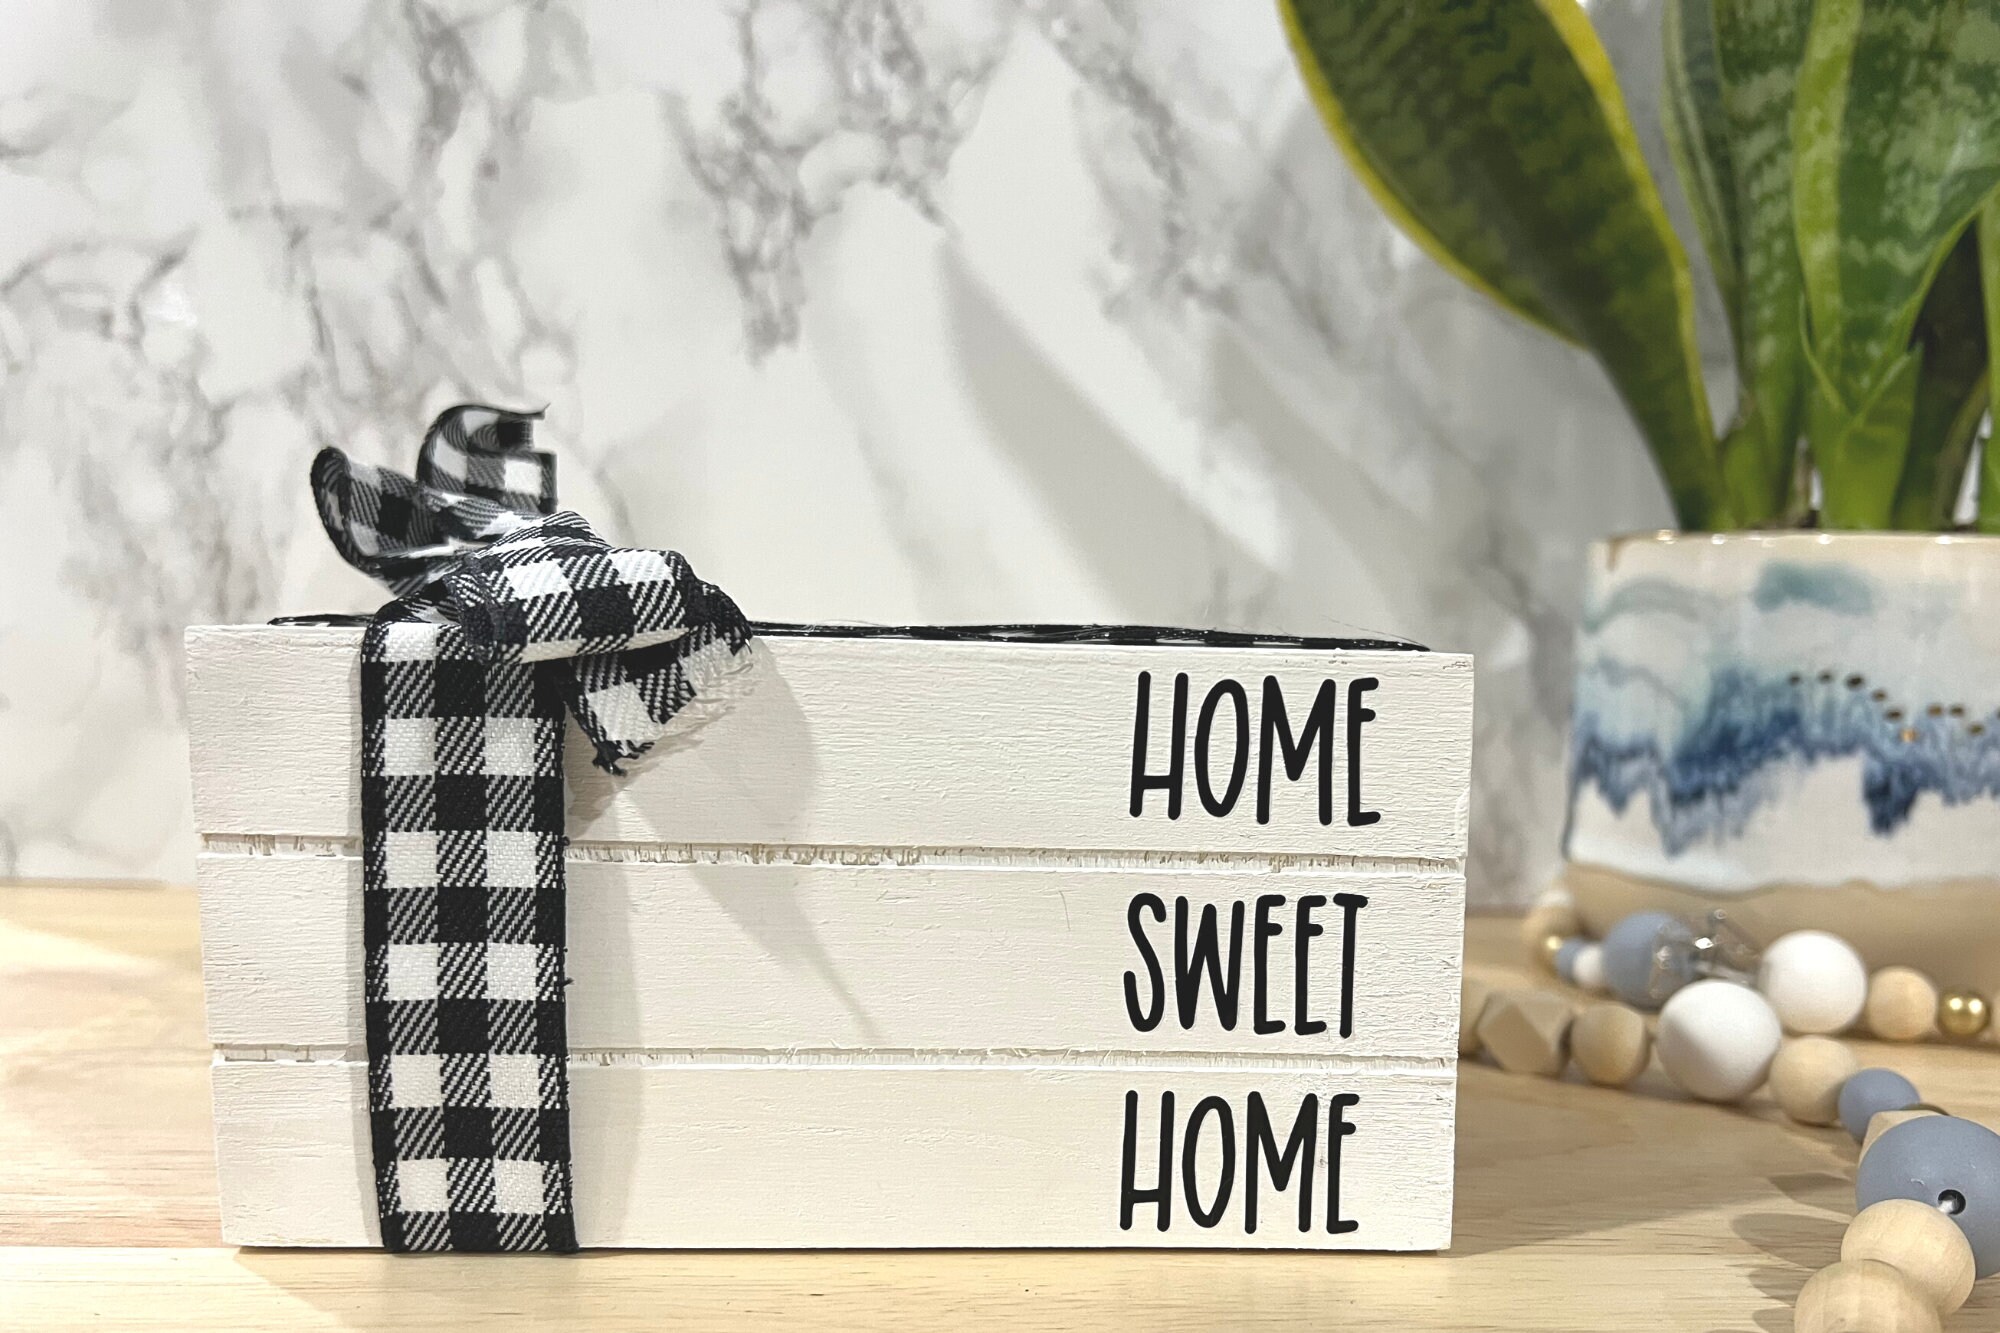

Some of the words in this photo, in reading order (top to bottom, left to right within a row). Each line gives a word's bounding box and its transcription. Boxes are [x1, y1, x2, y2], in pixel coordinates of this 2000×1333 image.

[1130, 670, 1381, 827] HOME
[1123, 892, 1369, 1039] SWEET
[1119, 1089, 1360, 1235] HOME
